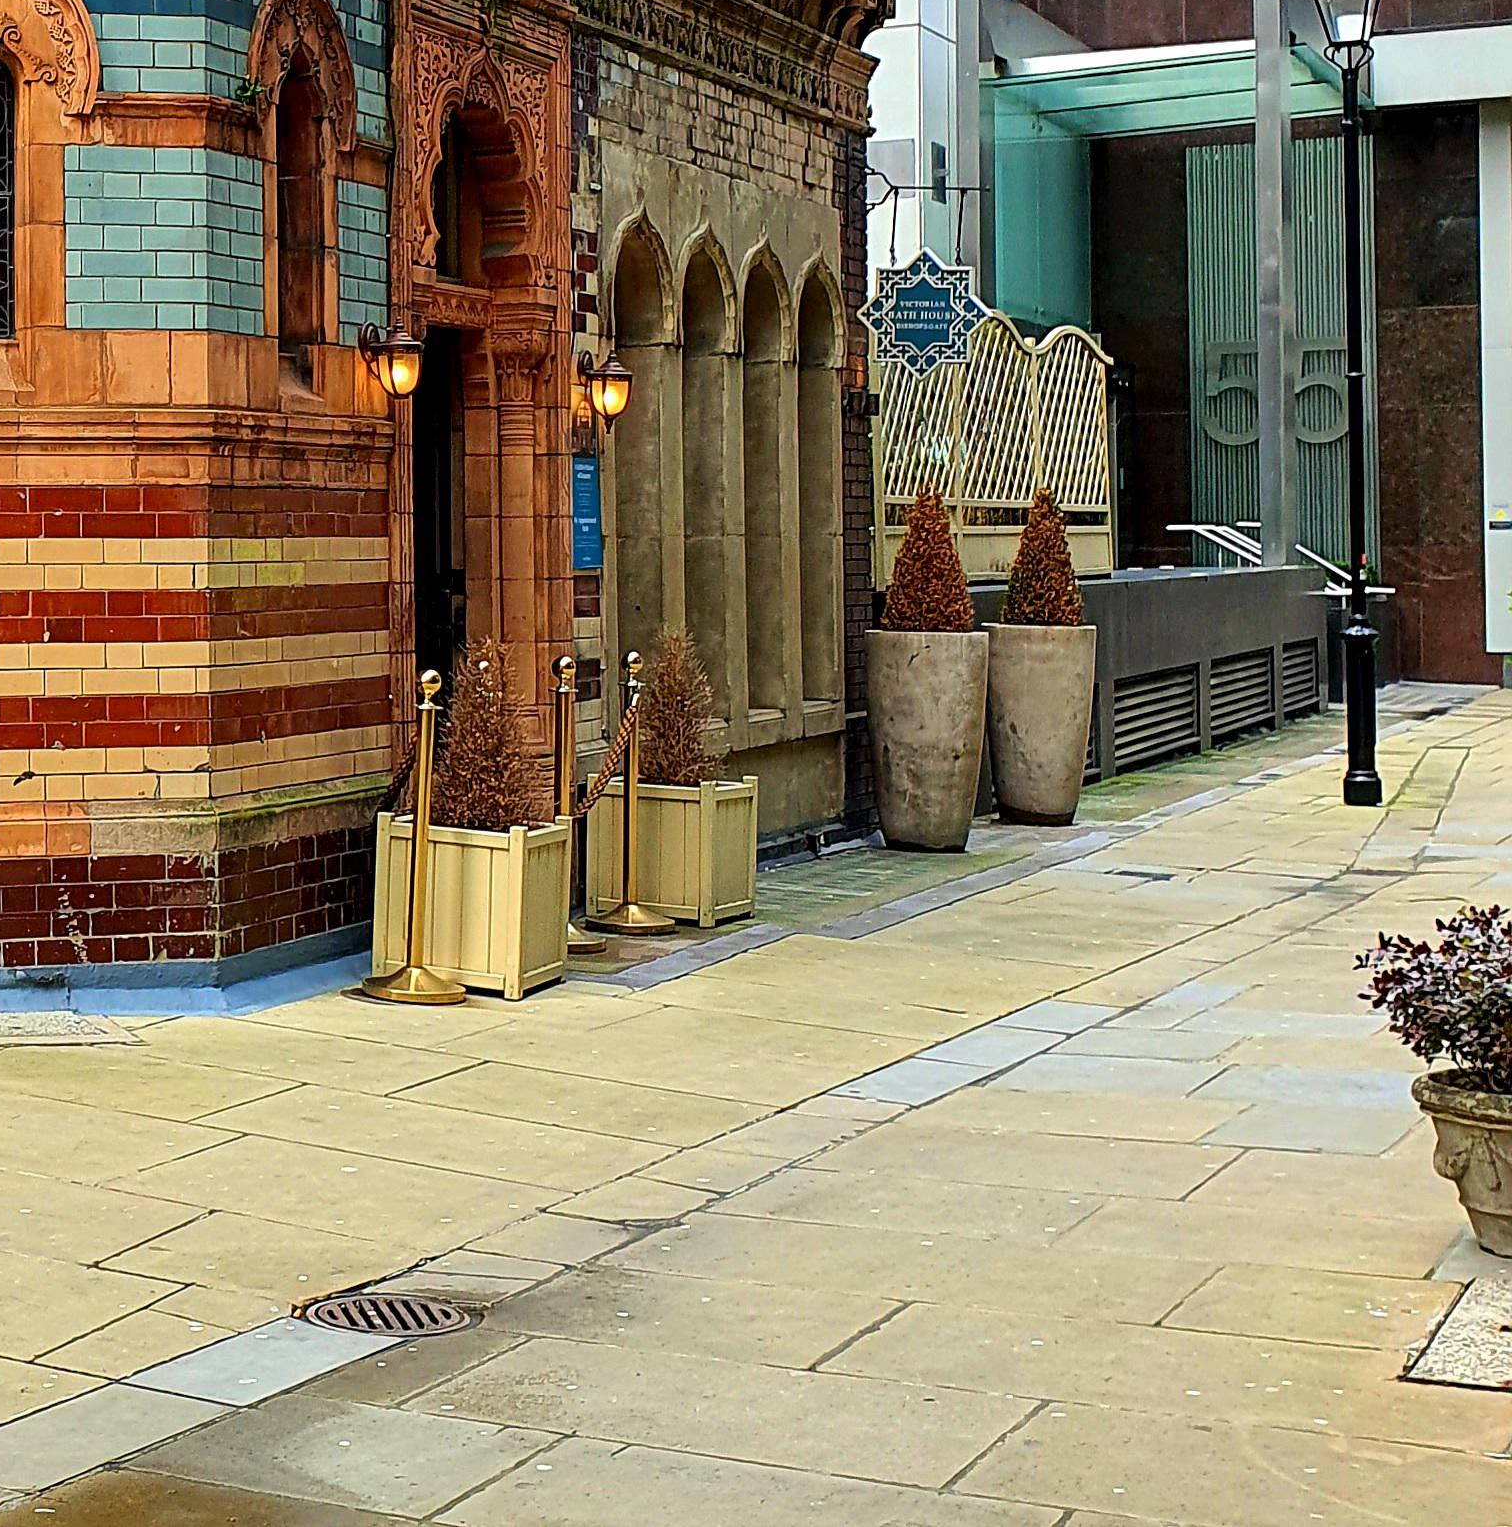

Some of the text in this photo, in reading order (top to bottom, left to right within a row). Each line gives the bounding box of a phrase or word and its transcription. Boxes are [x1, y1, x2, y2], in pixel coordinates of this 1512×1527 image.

[899, 300, 946, 308] VICTORIAN
[888, 310, 958, 320] BATH HOUSE
